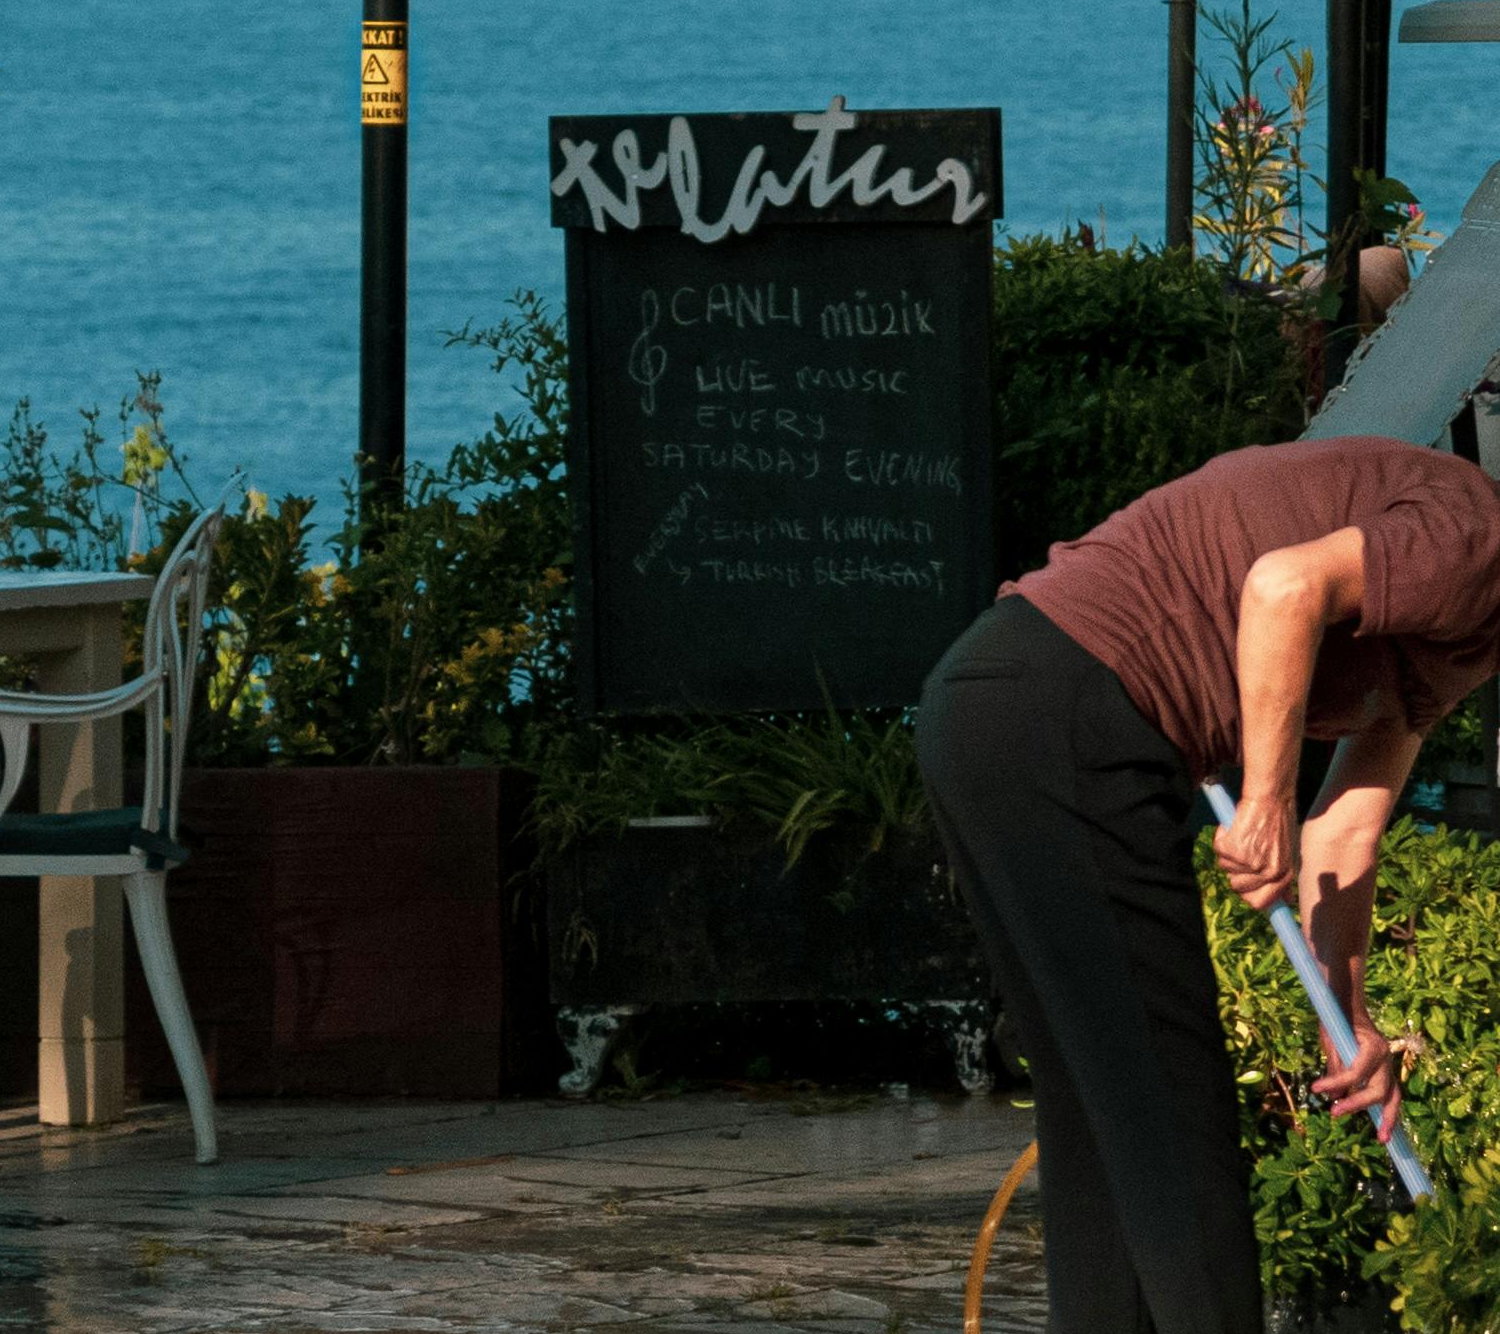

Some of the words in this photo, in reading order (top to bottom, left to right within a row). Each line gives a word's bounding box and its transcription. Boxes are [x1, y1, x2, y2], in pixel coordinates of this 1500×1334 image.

[670, 282, 803, 328] CANLI
[695, 360, 777, 394] LIVE
[796, 365, 909, 395] MUSIC
[696, 404, 826, 442] EVERY
[642, 441, 820, 480] SATURDAY
[844, 447, 963, 497] EVENING
